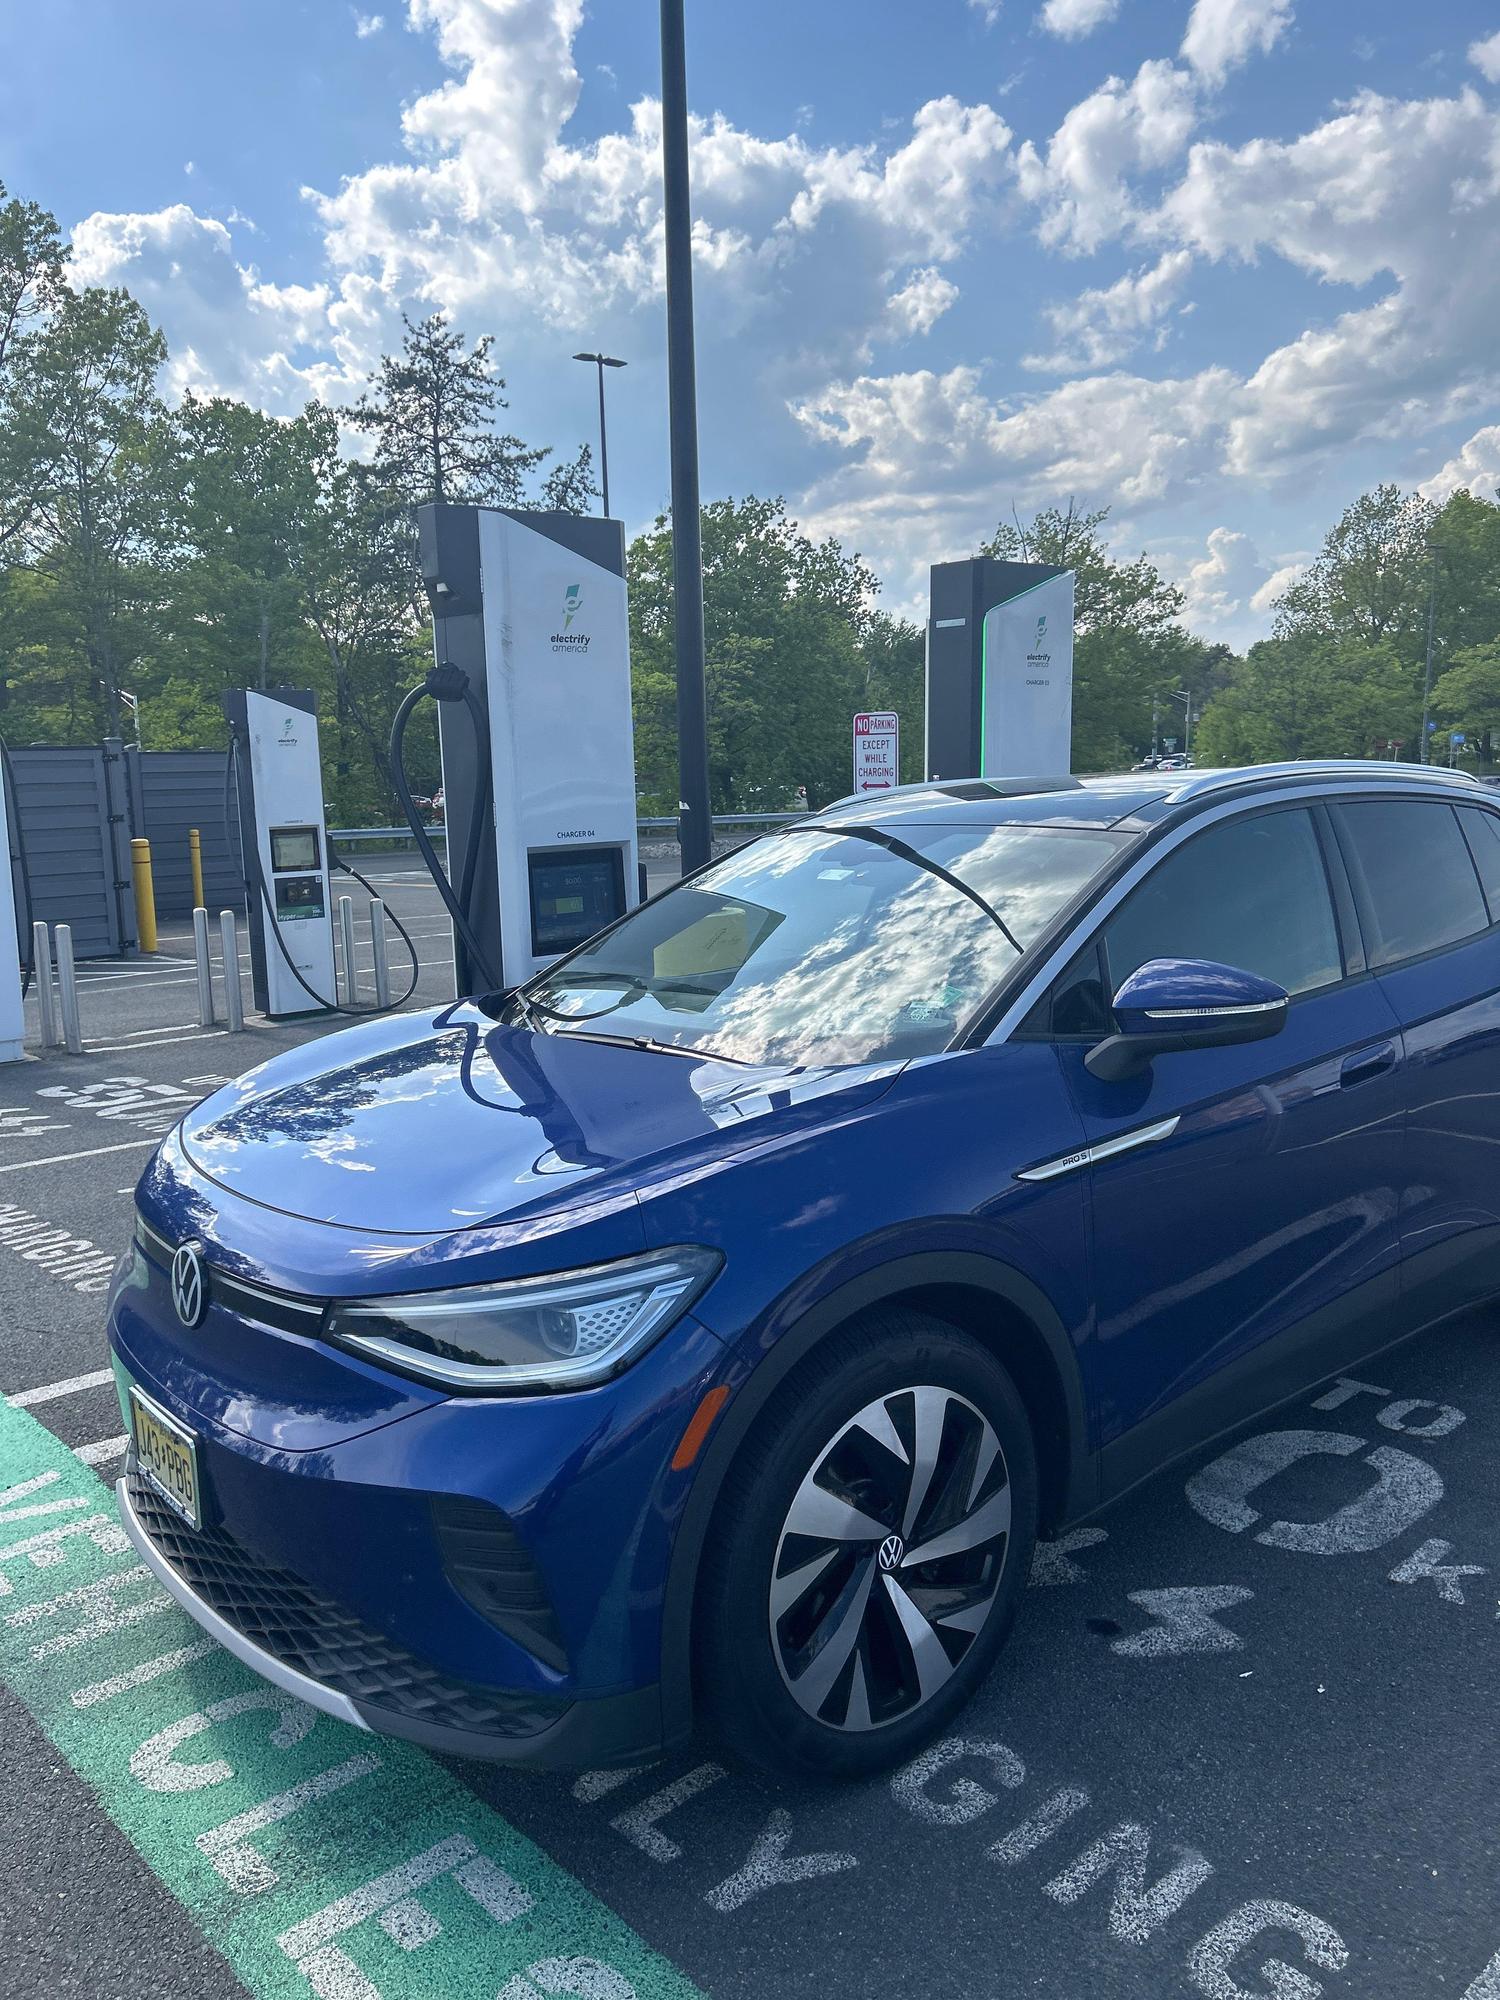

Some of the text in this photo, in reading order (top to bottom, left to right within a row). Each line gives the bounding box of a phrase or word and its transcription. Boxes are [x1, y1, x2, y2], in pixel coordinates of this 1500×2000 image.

[550, 633, 591, 646] electrify
[552, 644, 588, 653] america
[1026, 653, 1051, 662] electrify
[857, 718, 895, 732] NO PARKING
[862, 739, 890, 750] EXCEPT
[864, 753, 887, 764] WHILE
[858, 767, 894, 777] CHARGING
[556, 829, 595, 839] CHARGER 04
[1062, 1153, 1087, 1167] PRO S
[172, 1245, 202, 1327] VW
[878, 1535, 904, 1571] VW
